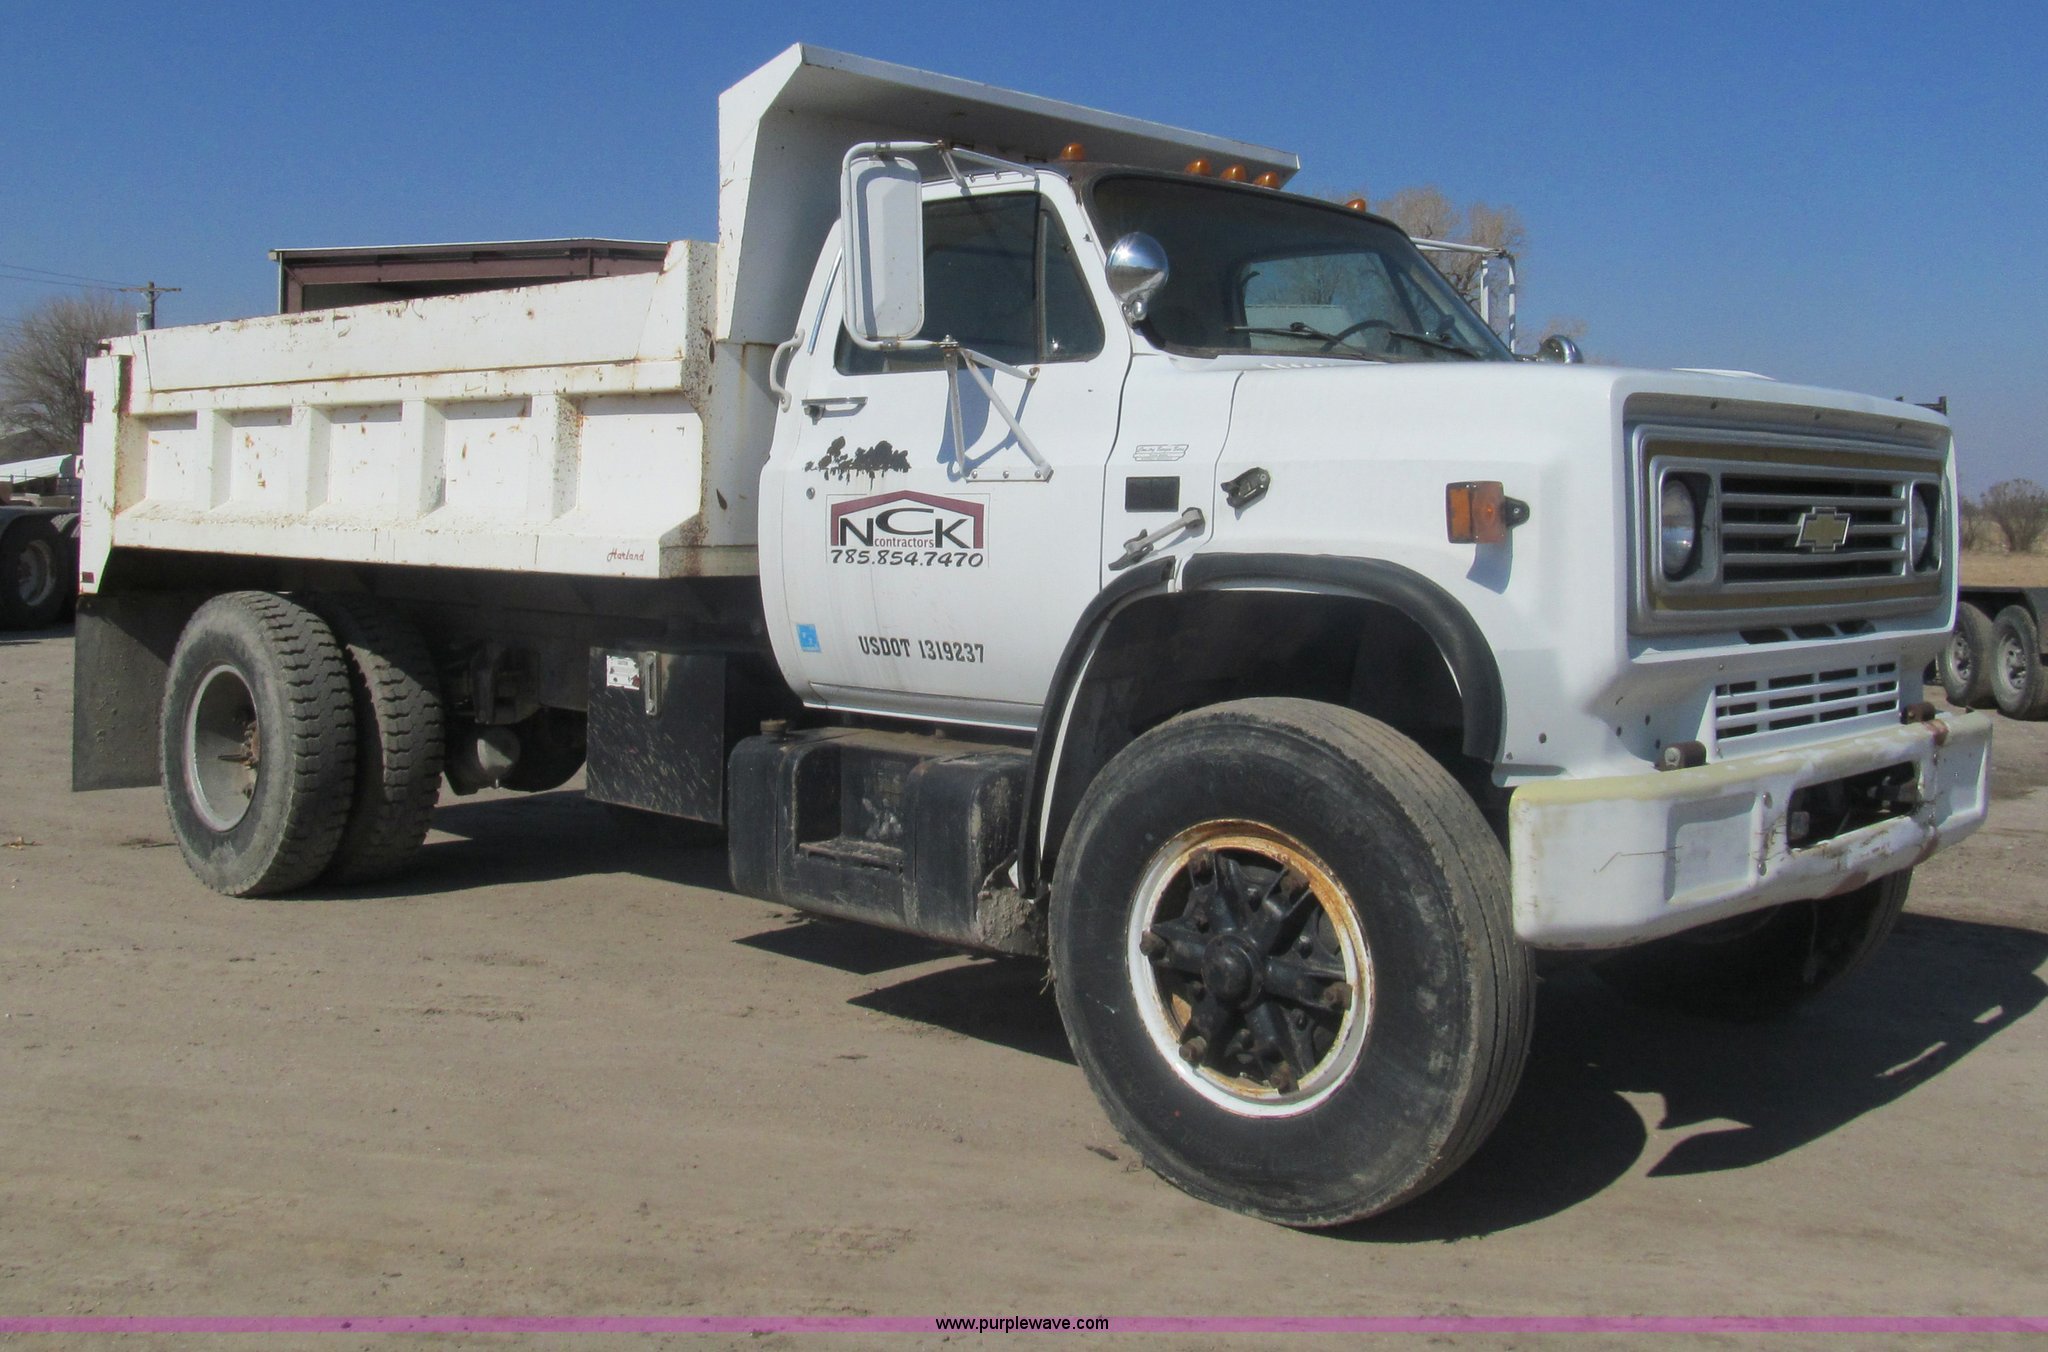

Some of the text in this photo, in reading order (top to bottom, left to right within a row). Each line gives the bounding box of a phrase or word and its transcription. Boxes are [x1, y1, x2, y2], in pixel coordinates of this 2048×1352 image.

[839, 507, 971, 549] NCK
[874, 537, 934, 548] contractors
[830, 549, 984, 568] 785.854.7470
[858, 636, 984, 663] USDOT 1319237
